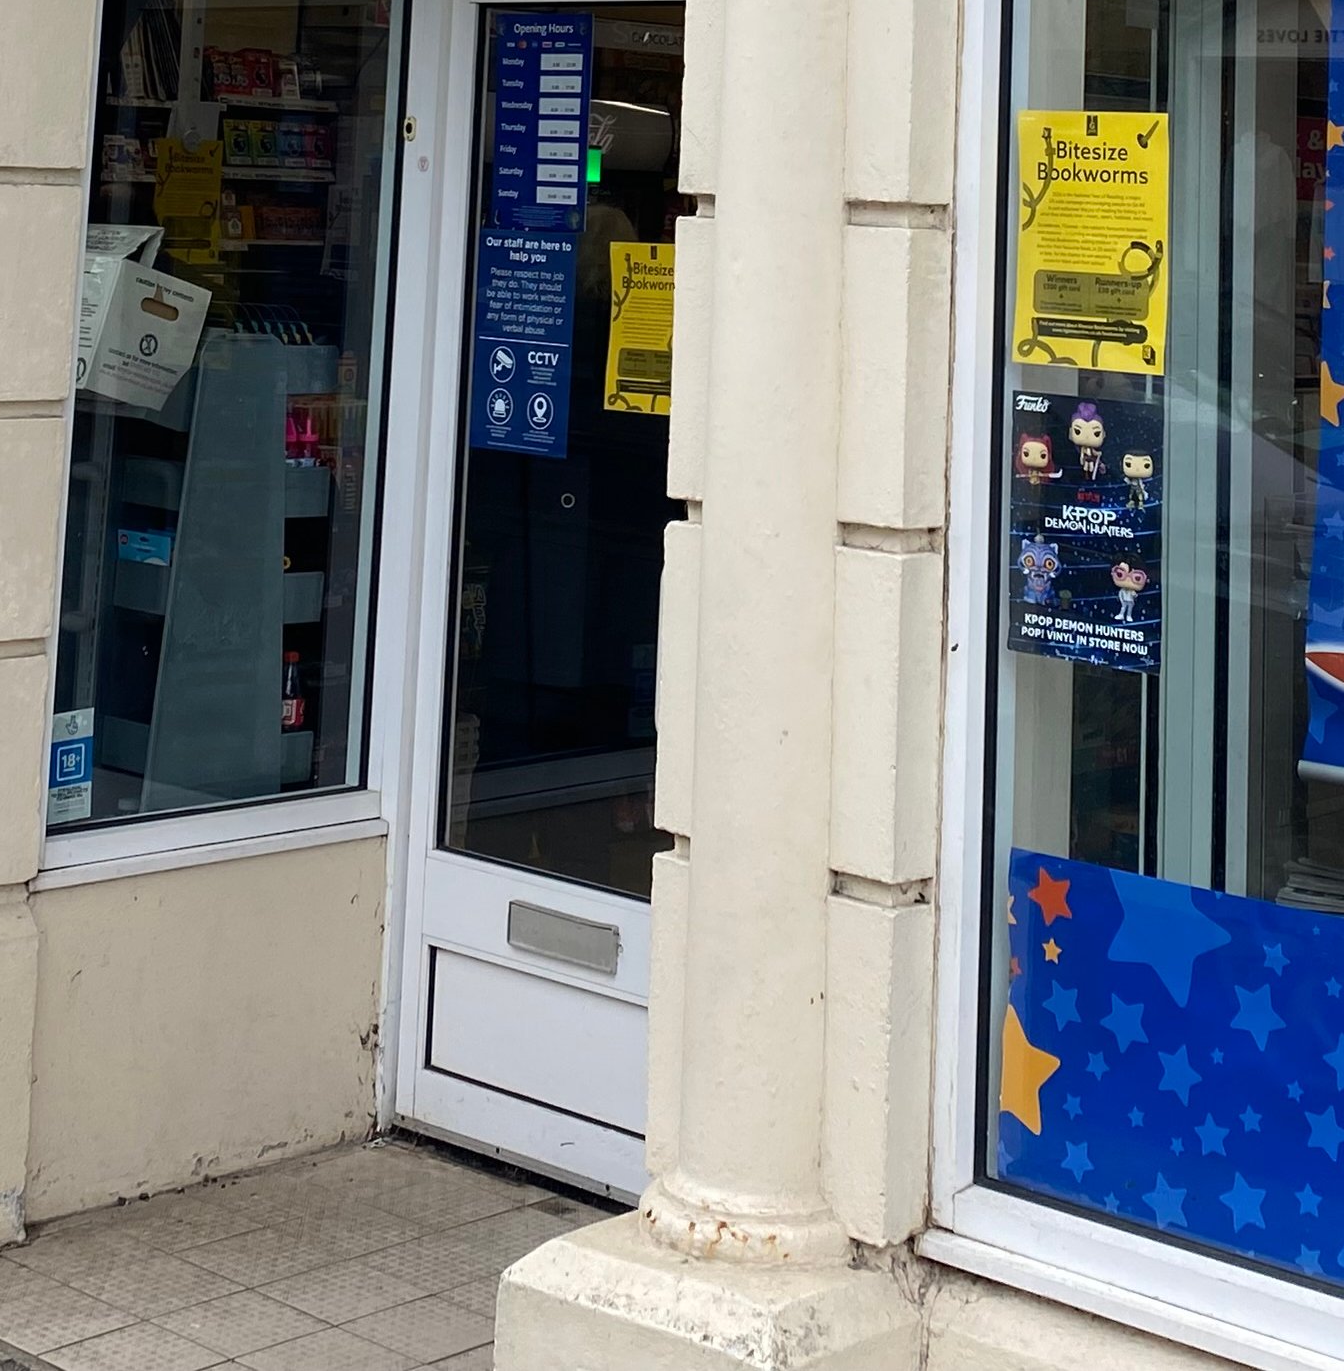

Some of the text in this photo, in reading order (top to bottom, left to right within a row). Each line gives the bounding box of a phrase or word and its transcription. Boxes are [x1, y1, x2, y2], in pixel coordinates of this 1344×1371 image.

[514, 23, 574, 37] Opening Hours
[502, 57, 525, 67] Monday
[502, 79, 524, 89] Tuesday
[501, 101, 533, 111] Wednesday
[501, 123, 526, 133] Thursday
[500, 145, 517, 155] Friday
[1056, 140, 1128, 162] Bitesize
[499, 167, 524, 177] Saturday
[1037, 162, 1149, 185] Bookworms
[498, 189, 519, 199] Sunday
[486, 236, 572, 252] Our staff are here to
[509, 251, 546, 263] help you
[490, 267, 565, 282] Please respect the job
[492, 279, 506, 290] they
[521, 281, 537, 292] They
[539, 281, 562, 292] should
[1046, 274, 1142, 290] Winners Runners-up
[486, 290, 566, 303] be able work without
[489, 299, 553, 313] fear intimidation
[486, 312, 555, 326] any form physical
[503, 324, 523, 334] verbal
[528, 351, 559, 367] CCTV
[1015, 395, 1051, 413] Funko
[1044, 517, 1134, 539] DEMON HUNTERS
[1024, 613, 1144, 642] KPOP DEMON HUNTERS
[1021, 626, 1148, 655] POP! VINYL IN STORE NOW
